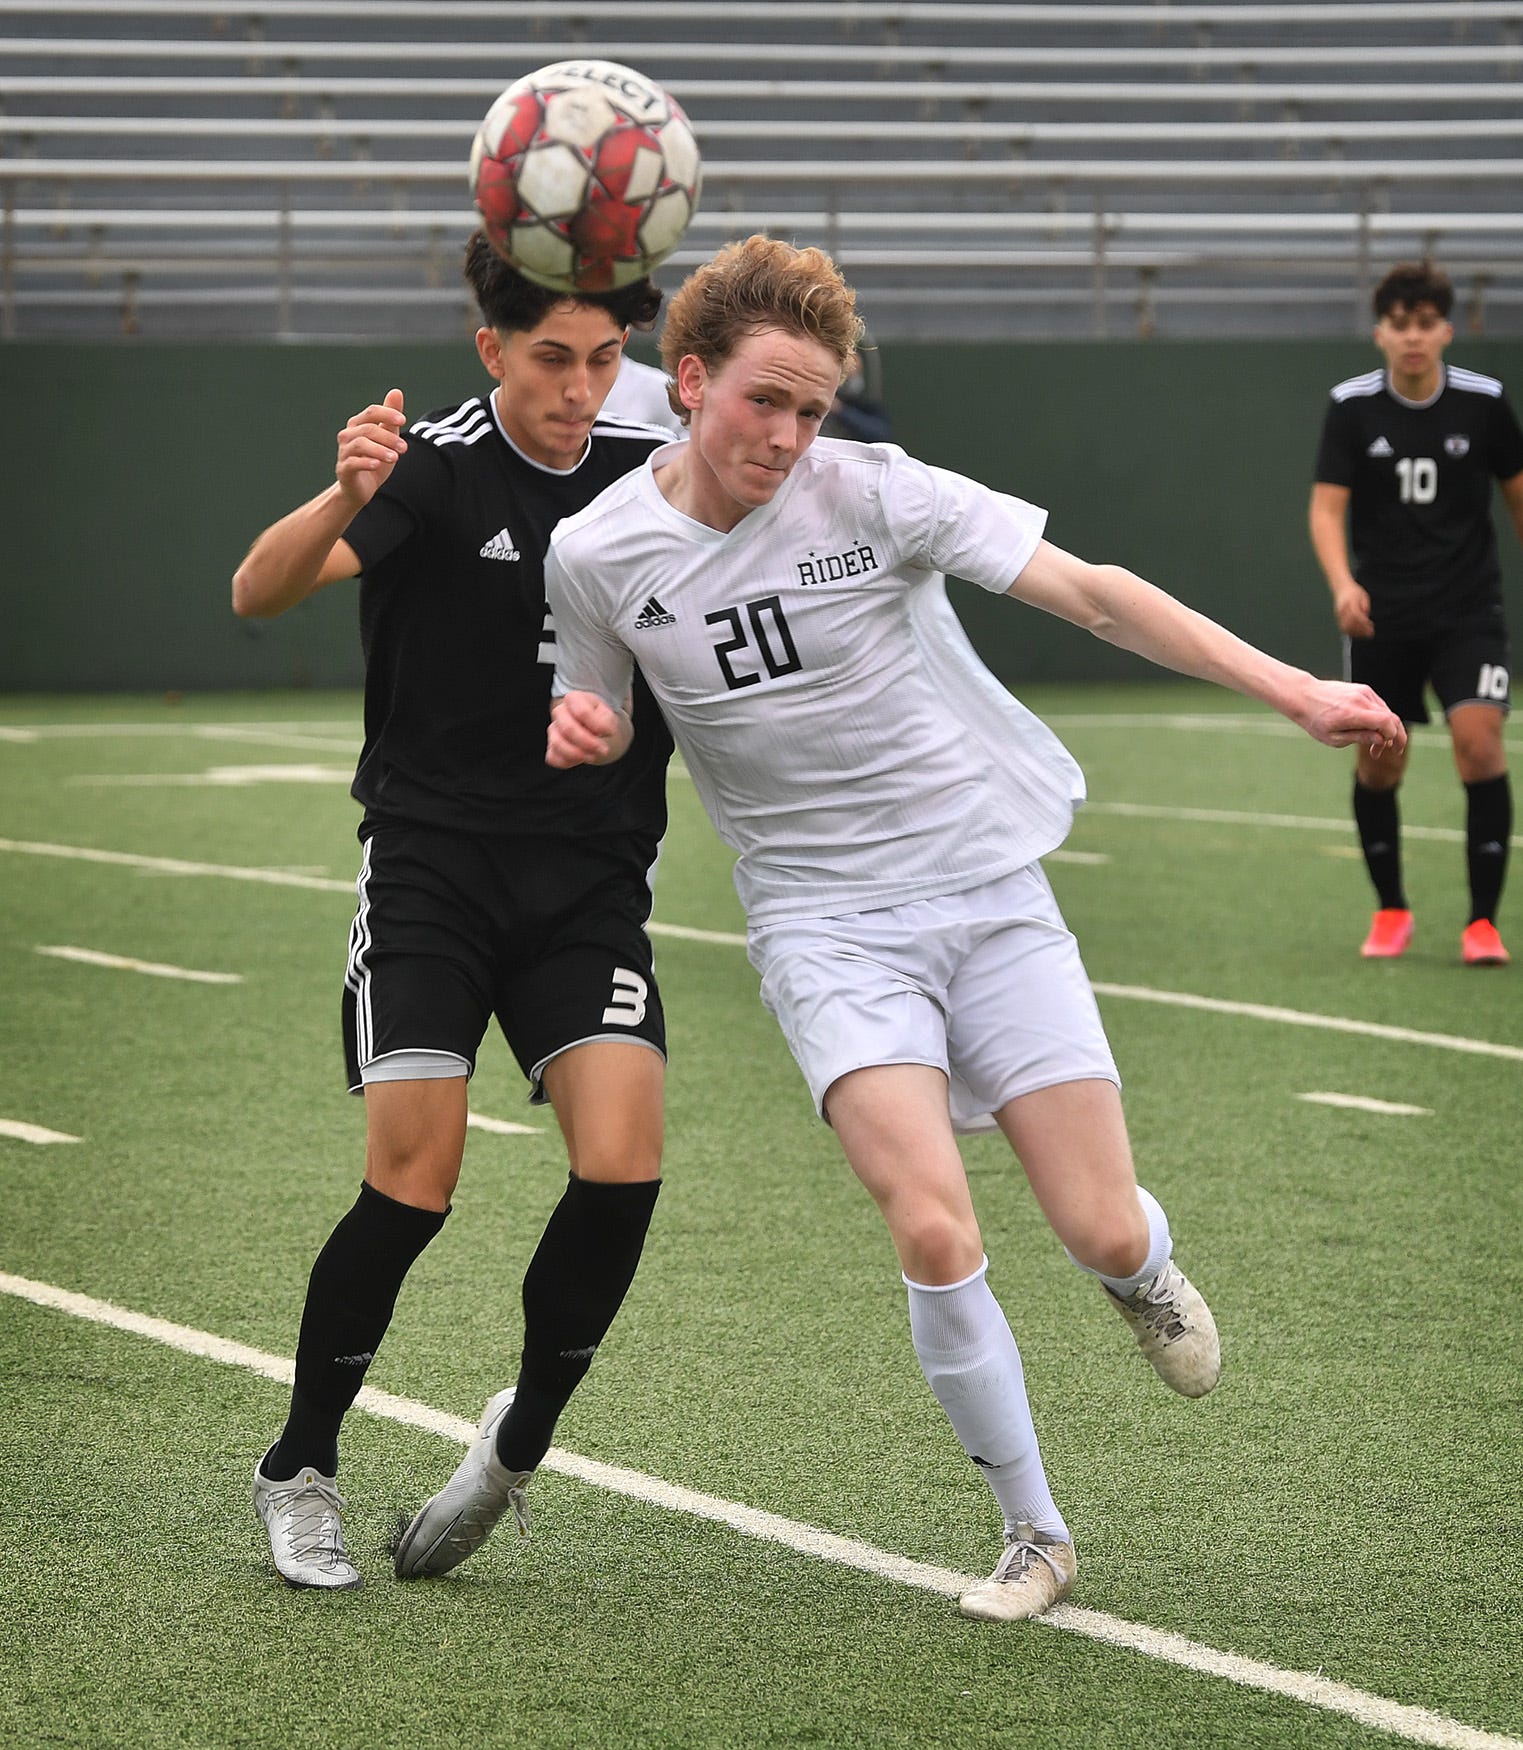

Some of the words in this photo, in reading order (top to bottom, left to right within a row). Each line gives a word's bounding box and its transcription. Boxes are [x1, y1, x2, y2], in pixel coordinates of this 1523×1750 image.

[547, 65, 661, 111] ELECT
[1395, 457, 1438, 504] 10
[479, 545, 521, 562] adidas
[797, 546, 878, 586] RIDER
[634, 612, 677, 630] adidas
[704, 595, 803, 690] 20
[1477, 663, 1509, 700] 10
[601, 966, 648, 1028] 3
